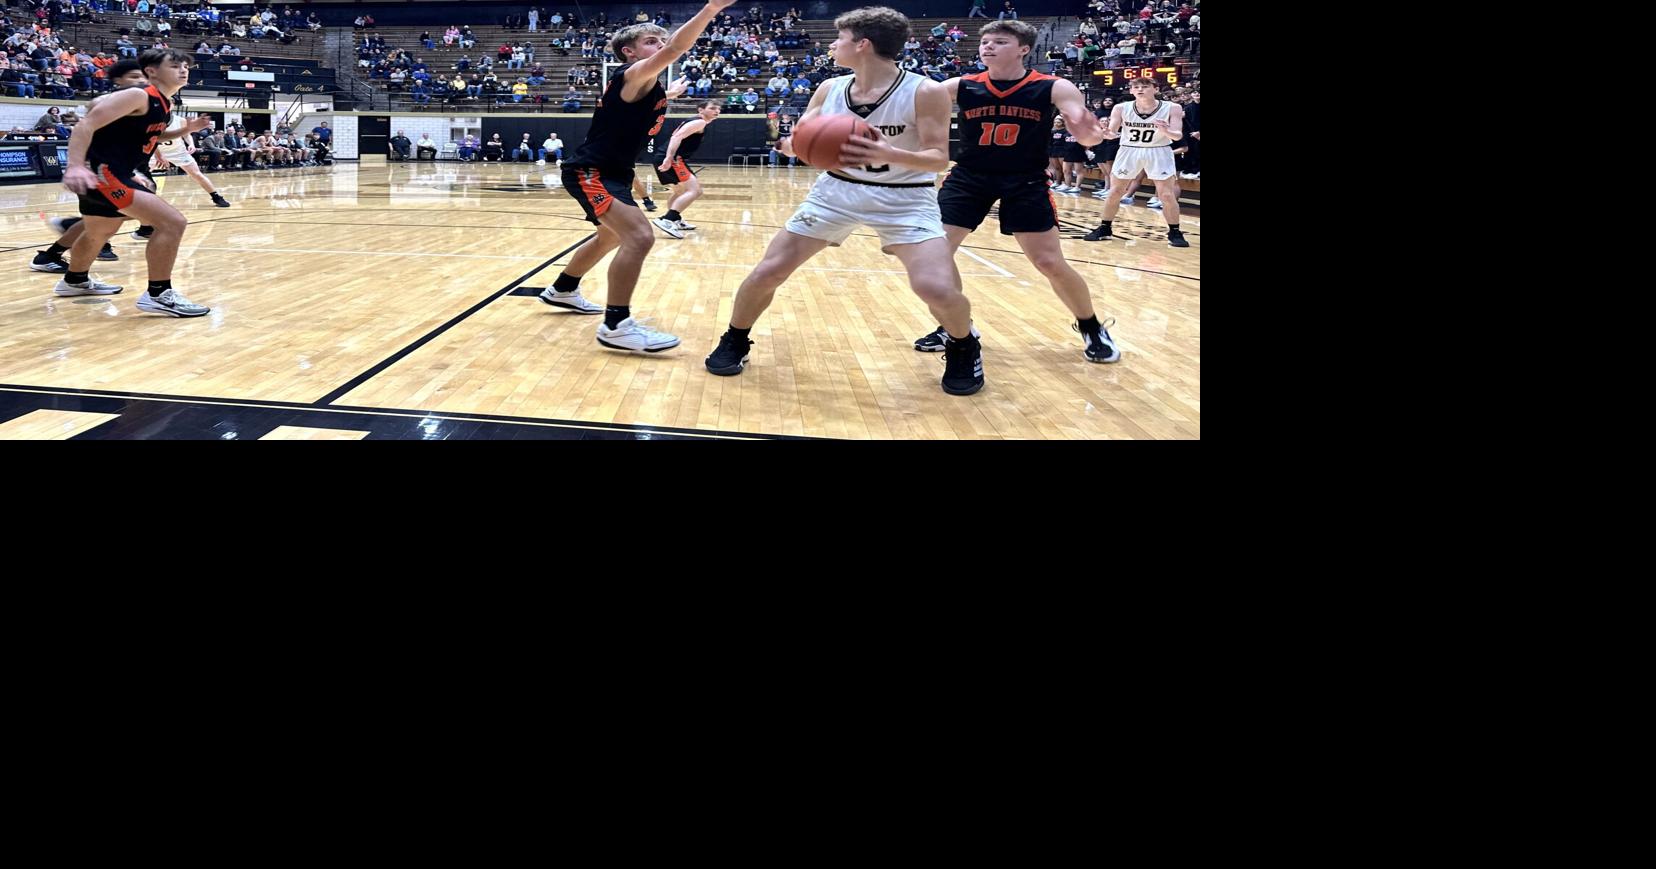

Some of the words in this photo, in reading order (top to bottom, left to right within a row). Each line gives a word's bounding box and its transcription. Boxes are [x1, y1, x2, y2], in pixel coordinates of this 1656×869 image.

[1123, 67, 1153, 79] 6:16
[1167, 72, 1177, 84] 6
[1104, 75, 1113, 86] 3
[964, 105, 996, 121] NORTH
[1000, 105, 1041, 122] DAVIESS
[978, 122, 1021, 147] 10
[1129, 129, 1155, 143] 30
